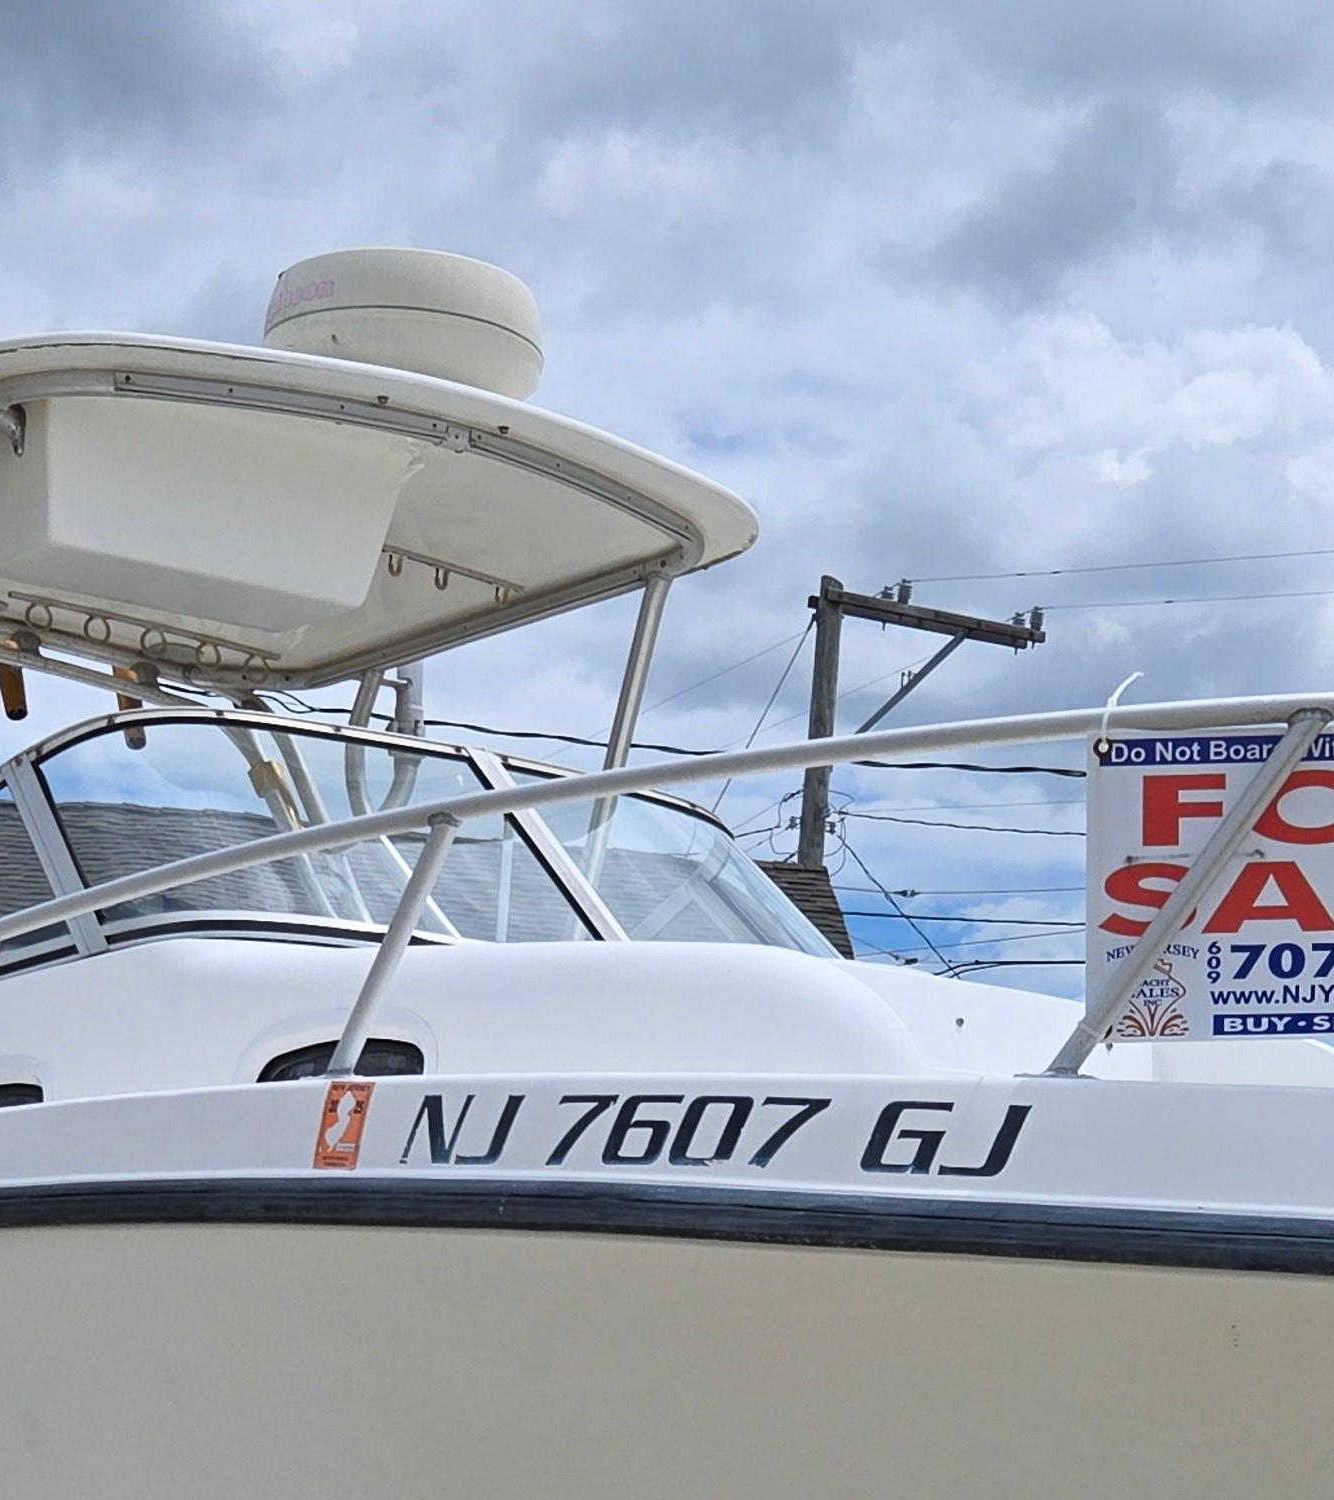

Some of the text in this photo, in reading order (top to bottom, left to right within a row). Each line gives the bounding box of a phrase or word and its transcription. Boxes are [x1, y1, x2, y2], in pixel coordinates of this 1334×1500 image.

[1110, 743, 1146, 763] Do
[1155, 741, 1201, 762] Not
[1209, 740, 1275, 761] Boar
[1206, 940, 1222, 985] 609
[1131, 987, 1181, 998] ALES
[1140, 978, 1170, 988] ACHT
[1222, 1016, 1293, 1033] BUY
[398, 1094, 1034, 1178] NJ 7607 GJ
